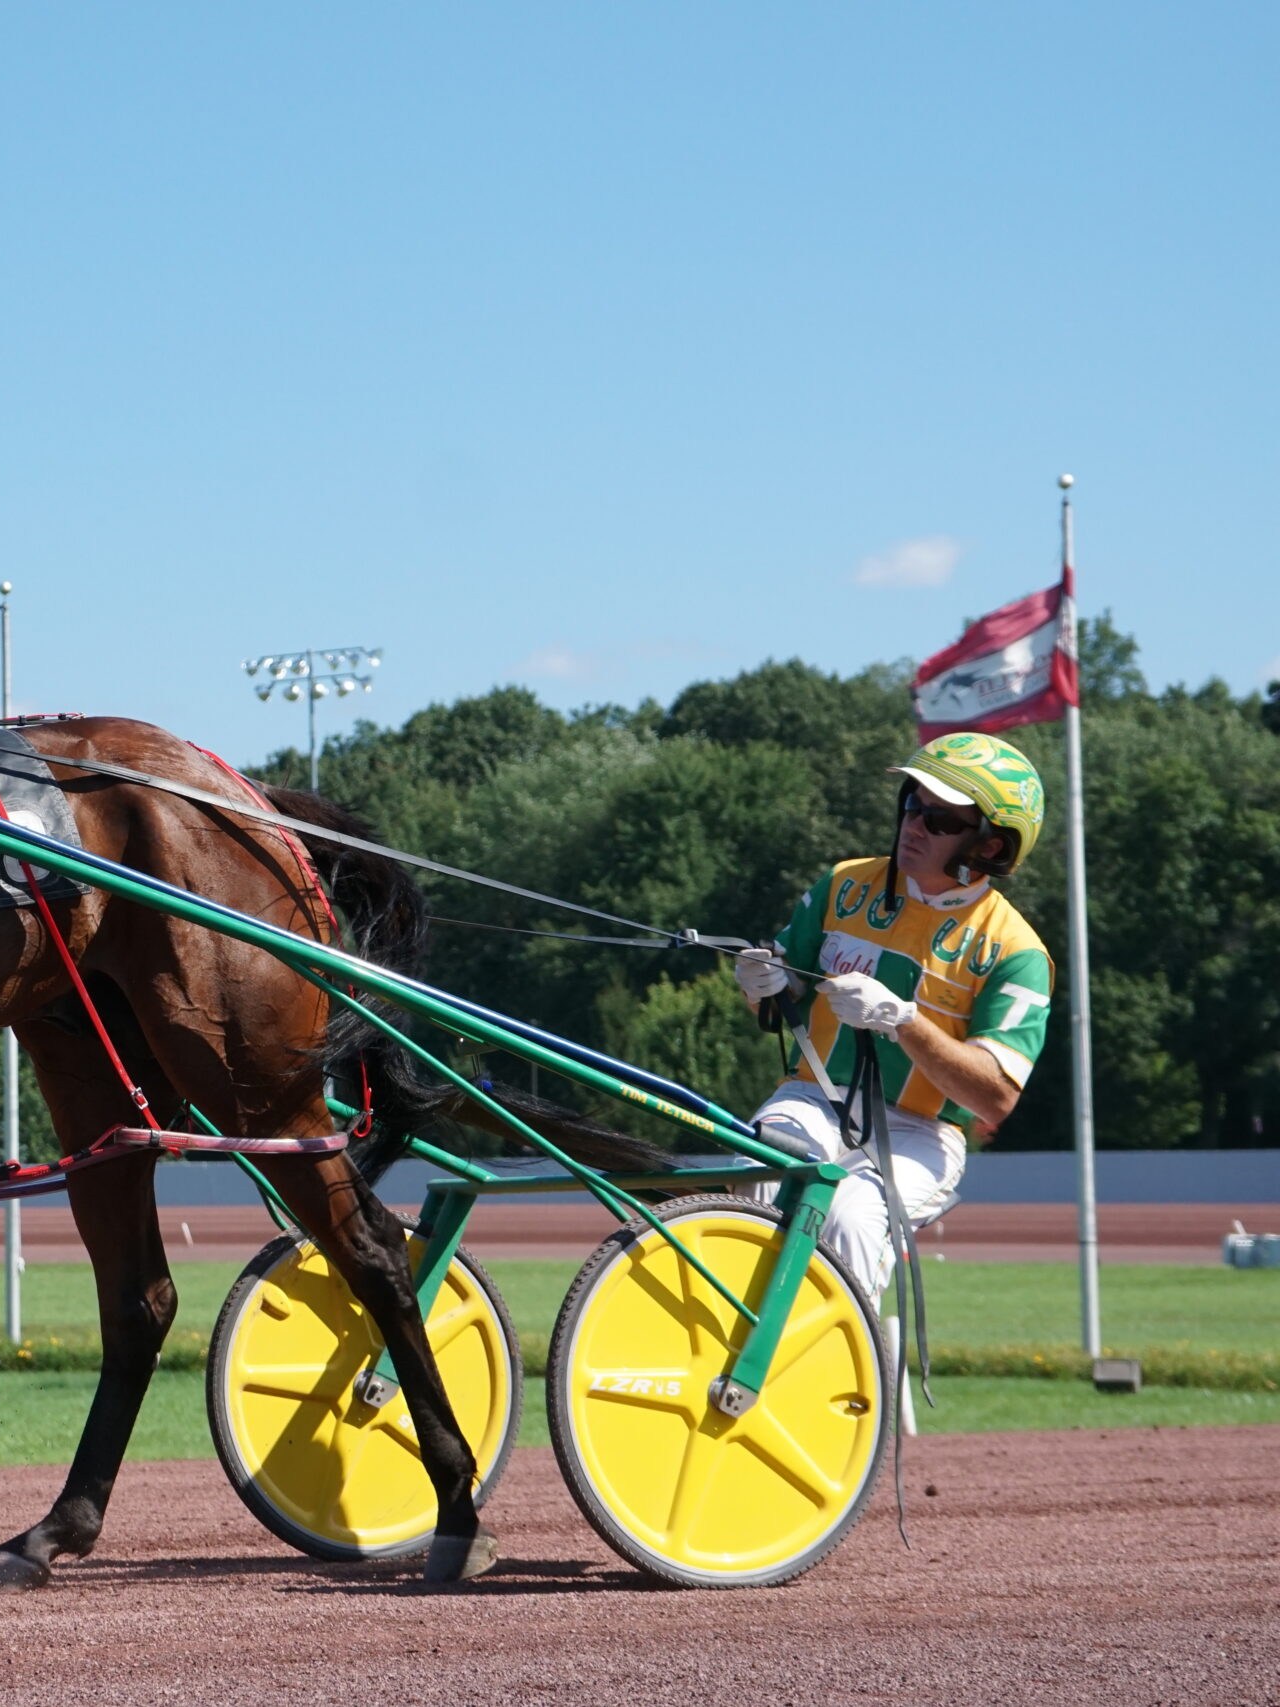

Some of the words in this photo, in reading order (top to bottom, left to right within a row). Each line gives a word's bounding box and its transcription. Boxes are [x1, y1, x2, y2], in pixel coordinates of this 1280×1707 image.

[998, 982, 1051, 1032] T
[620, 1084, 648, 1104] TIM
[655, 1098, 715, 1133] TETRICK
